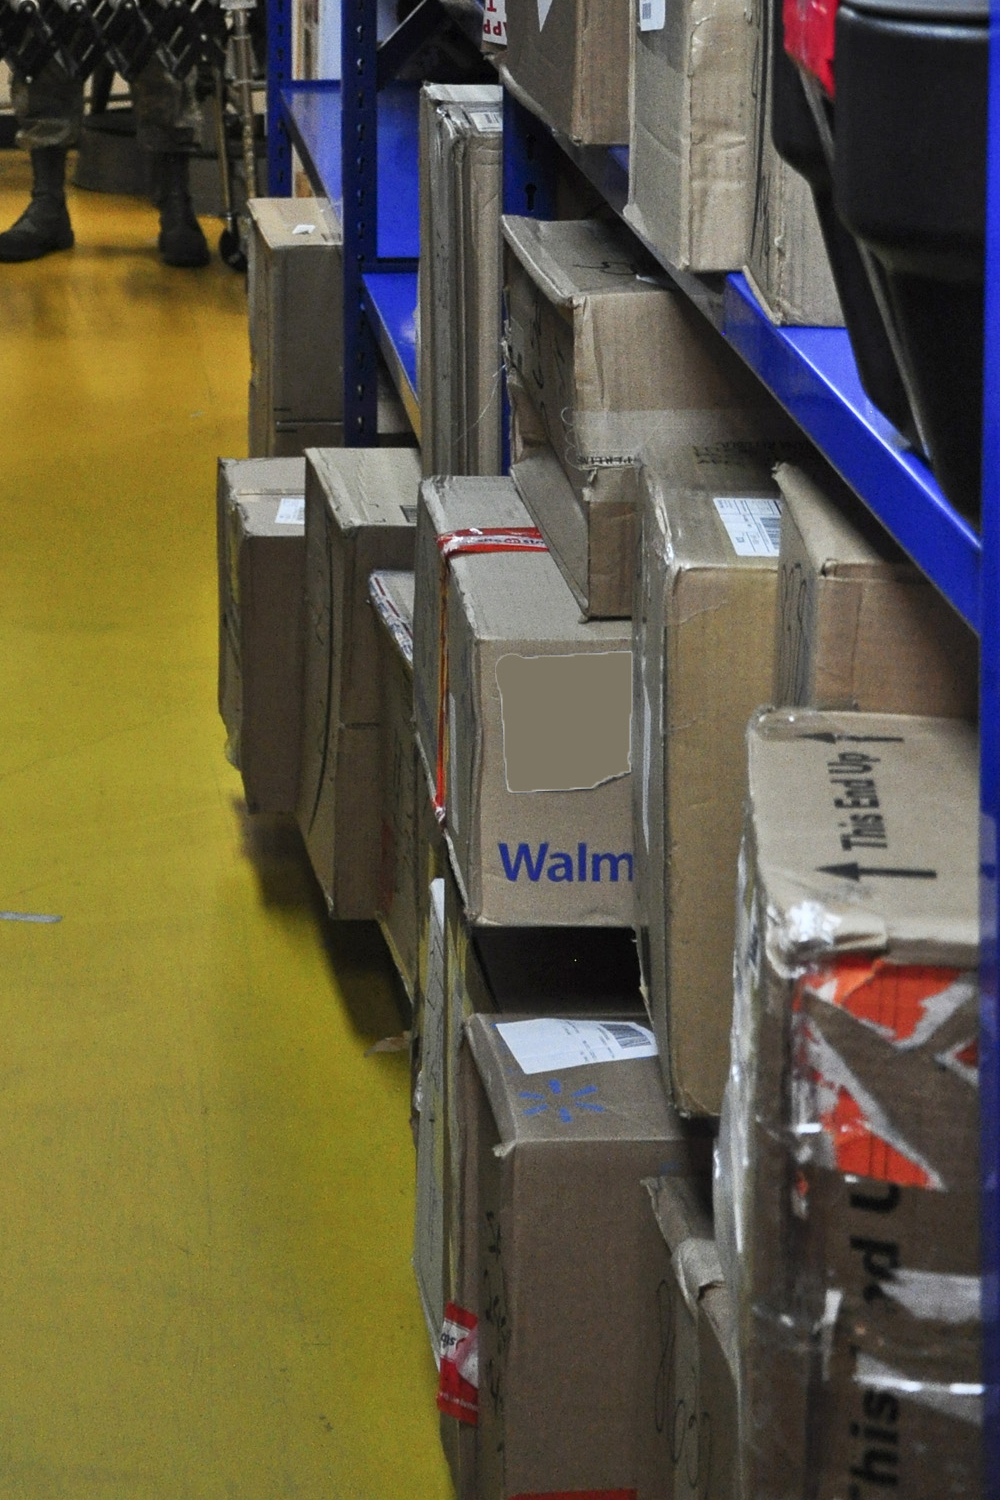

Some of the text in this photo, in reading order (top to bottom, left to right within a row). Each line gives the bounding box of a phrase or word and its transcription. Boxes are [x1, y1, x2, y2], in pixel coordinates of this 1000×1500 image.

[826, 751, 888, 852] This End Up
